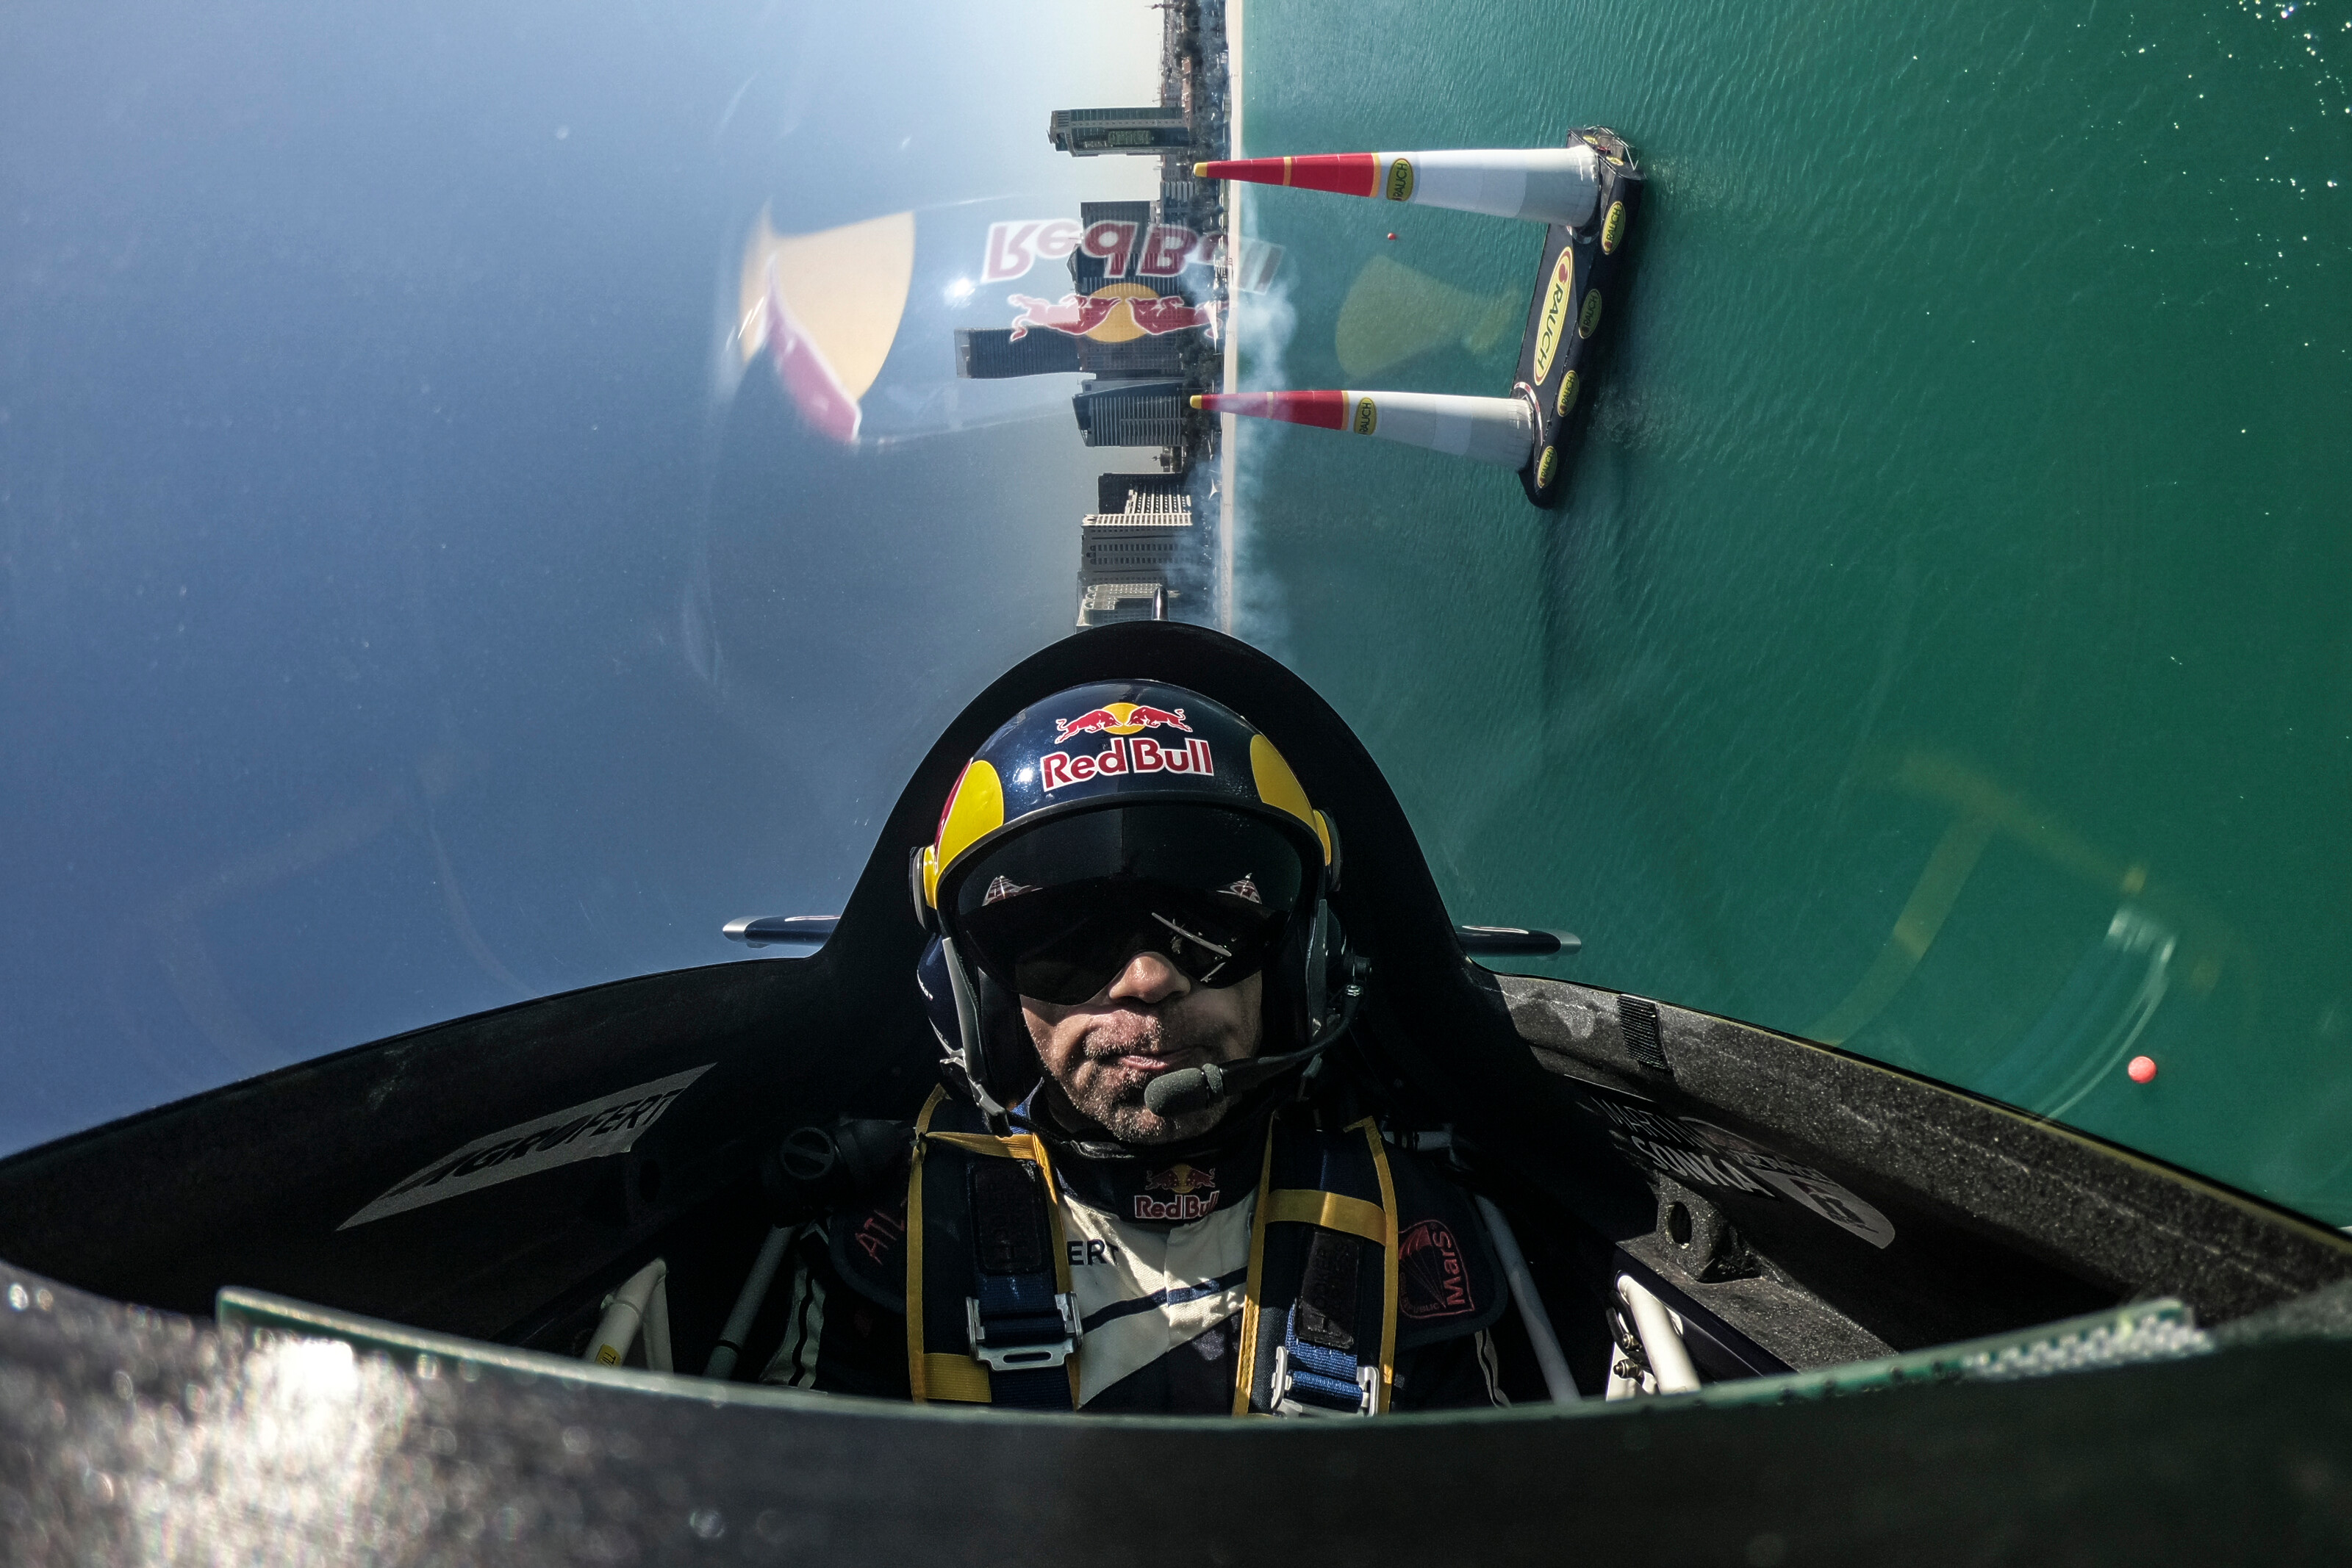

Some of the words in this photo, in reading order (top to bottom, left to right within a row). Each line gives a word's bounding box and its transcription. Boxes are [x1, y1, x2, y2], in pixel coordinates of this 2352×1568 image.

[1393, 162, 1408, 197] RAUCH
[1606, 207, 1621, 241] RAUCH
[1538, 283, 1563, 370] RAUCH
[1584, 295, 1598, 327] RAUCH
[1561, 375, 1575, 405] RAUCH
[1359, 402, 1372, 432] RAUCH
[1541, 450, 1554, 477] RAUCH
[1040, 737, 1128, 792] Red
[1130, 738, 1214, 776] Bull
[1588, 1096, 1719, 1154] MARTIN
[1630, 1135, 1776, 1199] SONKA
[1134, 1194, 1183, 1220] Red
[1183, 1190, 1220, 1220] Bull
[855, 1197, 907, 1266] ATL
